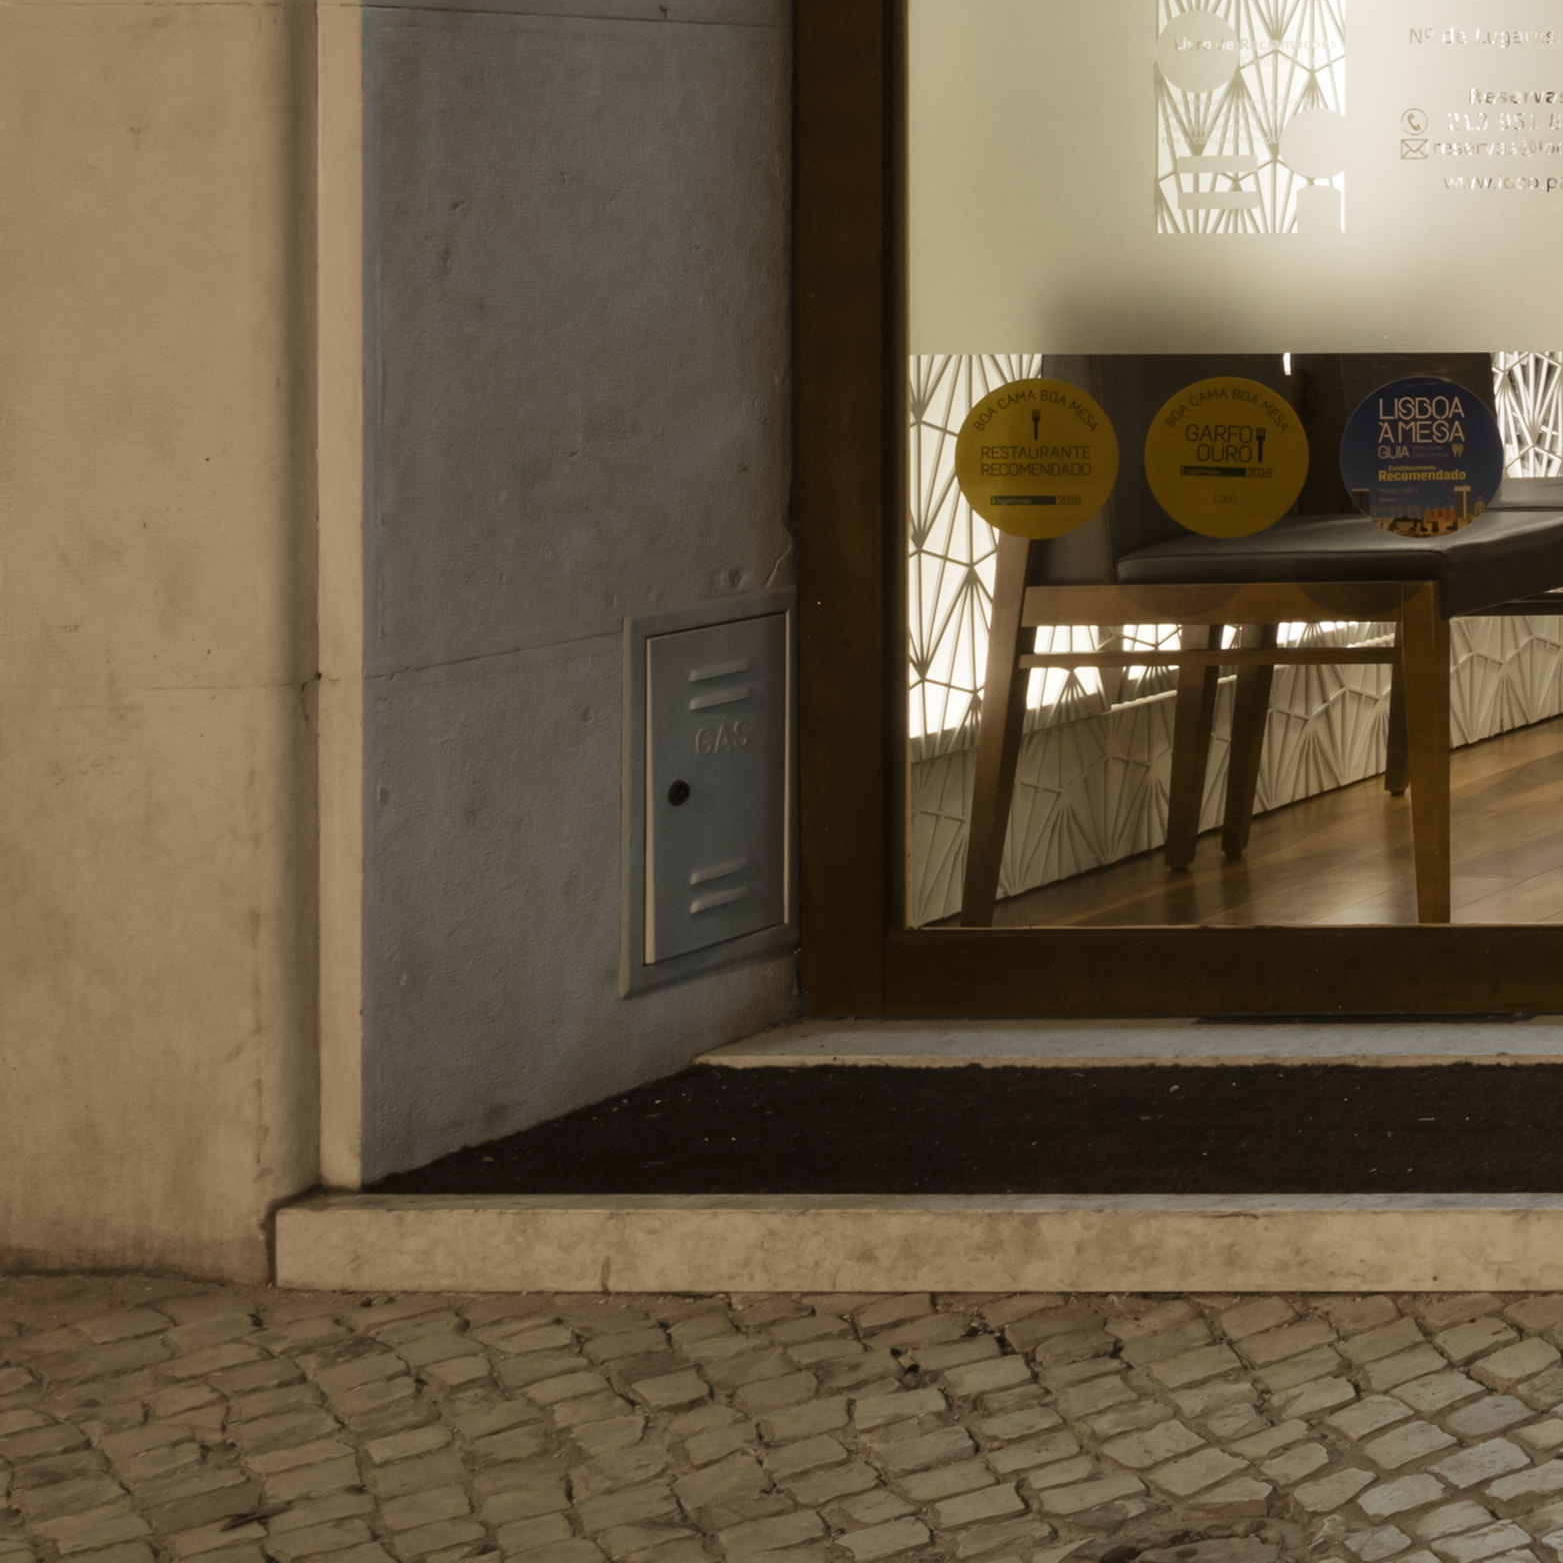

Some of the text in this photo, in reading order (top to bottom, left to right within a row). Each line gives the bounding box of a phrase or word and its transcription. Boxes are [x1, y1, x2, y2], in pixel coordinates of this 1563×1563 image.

[1442, 27, 1468, 45] de
[973, 389, 1098, 432] BOA CAMA BOA MESA
[1164, 388, 1291, 433] BOA CAMA BOA MESA
[1379, 396, 1465, 420] LISBOA
[1185, 423, 1253, 444] GARFO
[1398, 420, 1465, 444] MESA
[980, 445, 1092, 459] RESTAURANTE
[1196, 443, 1253, 463] OURO
[1378, 444, 1411, 459] GUIA
[980, 462, 1092, 477] RECOMENDADO
[1378, 469, 1467, 481] Recomendado
[695, 715, 748, 755] GAS
